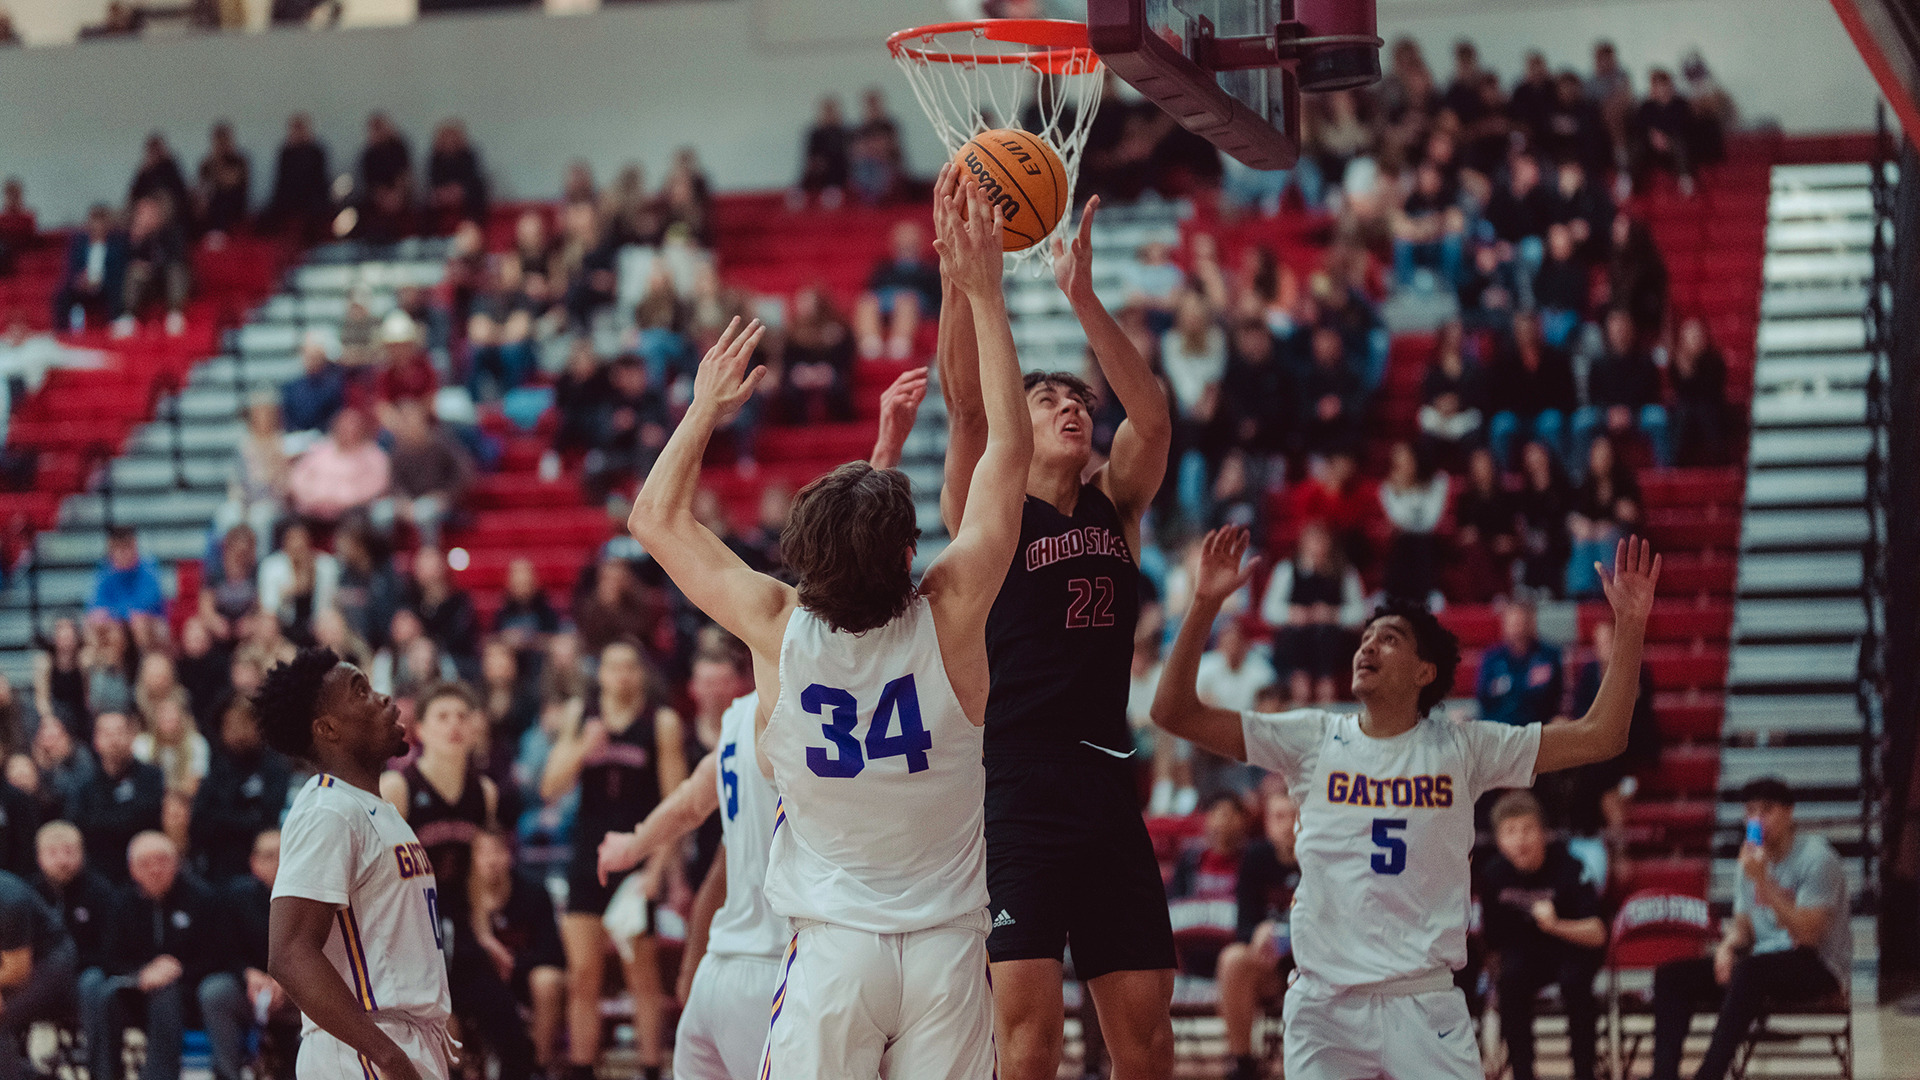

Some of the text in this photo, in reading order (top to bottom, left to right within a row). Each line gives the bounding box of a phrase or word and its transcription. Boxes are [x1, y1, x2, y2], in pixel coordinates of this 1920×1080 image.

[1026, 529, 1084, 572] CHICO
[1066, 577, 1114, 628] 22
[801, 673, 932, 778] 34
[1327, 770, 1453, 808] GATORS
[1371, 818, 1407, 875] 5
[993, 918, 1016, 928] adidas
